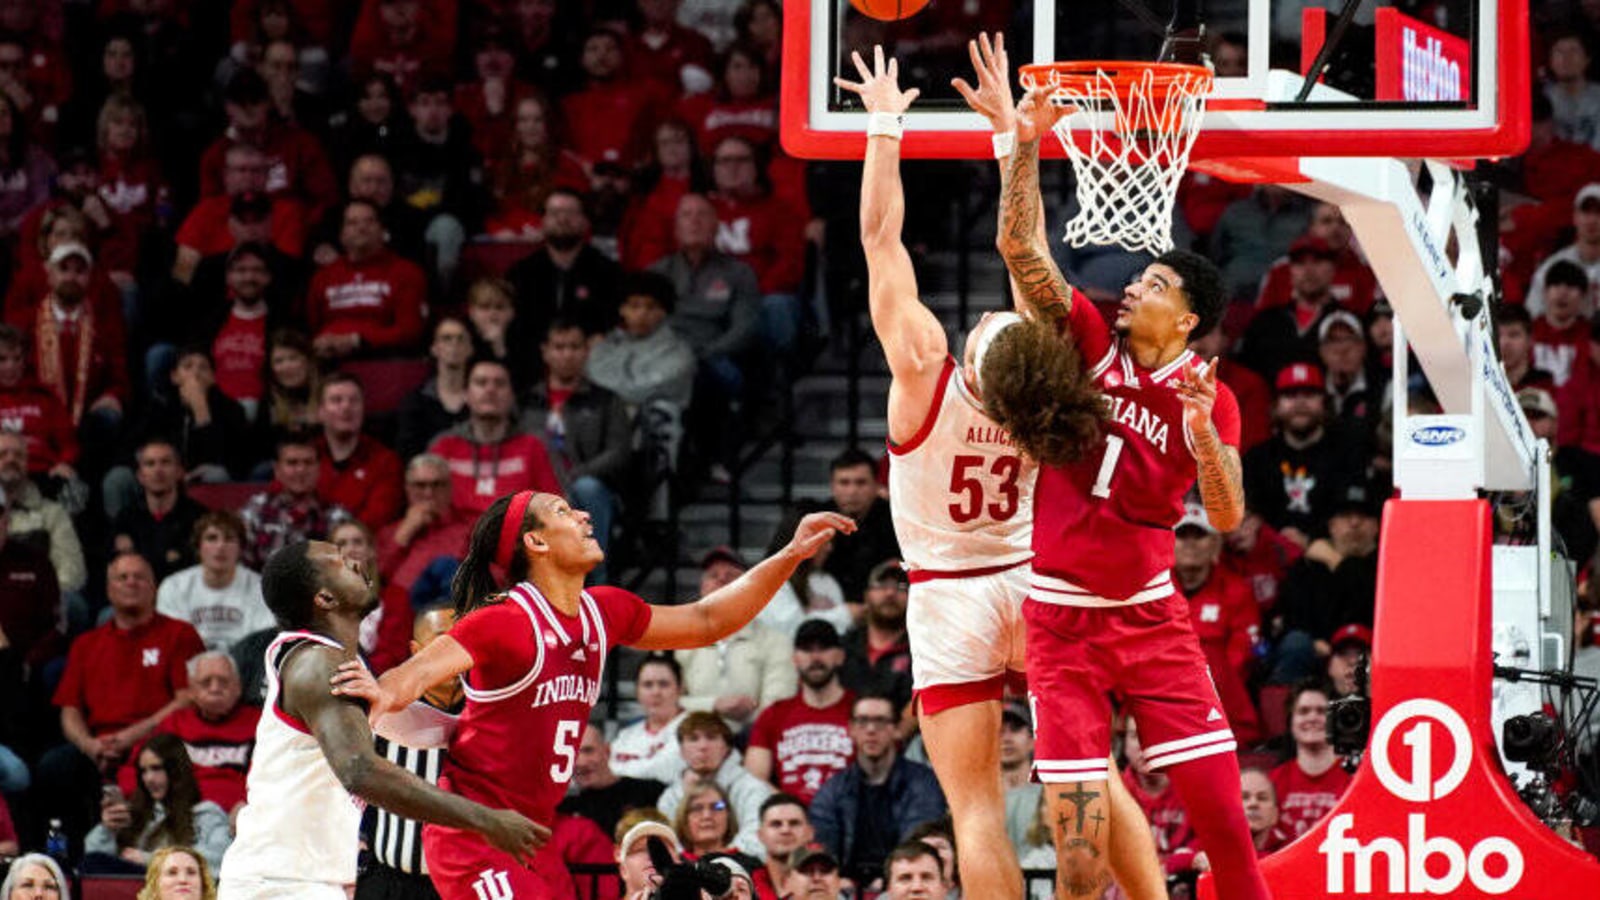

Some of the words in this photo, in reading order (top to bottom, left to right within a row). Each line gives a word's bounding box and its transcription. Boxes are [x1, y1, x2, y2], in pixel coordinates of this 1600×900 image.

[715, 217, 751, 254] N
[949, 455, 1022, 523] 53
[1091, 434, 1124, 499] 1
[142, 648, 160, 667] N
[531, 674, 598, 708] INDIAN
[550, 719, 581, 783] 5
[1318, 813, 1525, 895] fnbo
